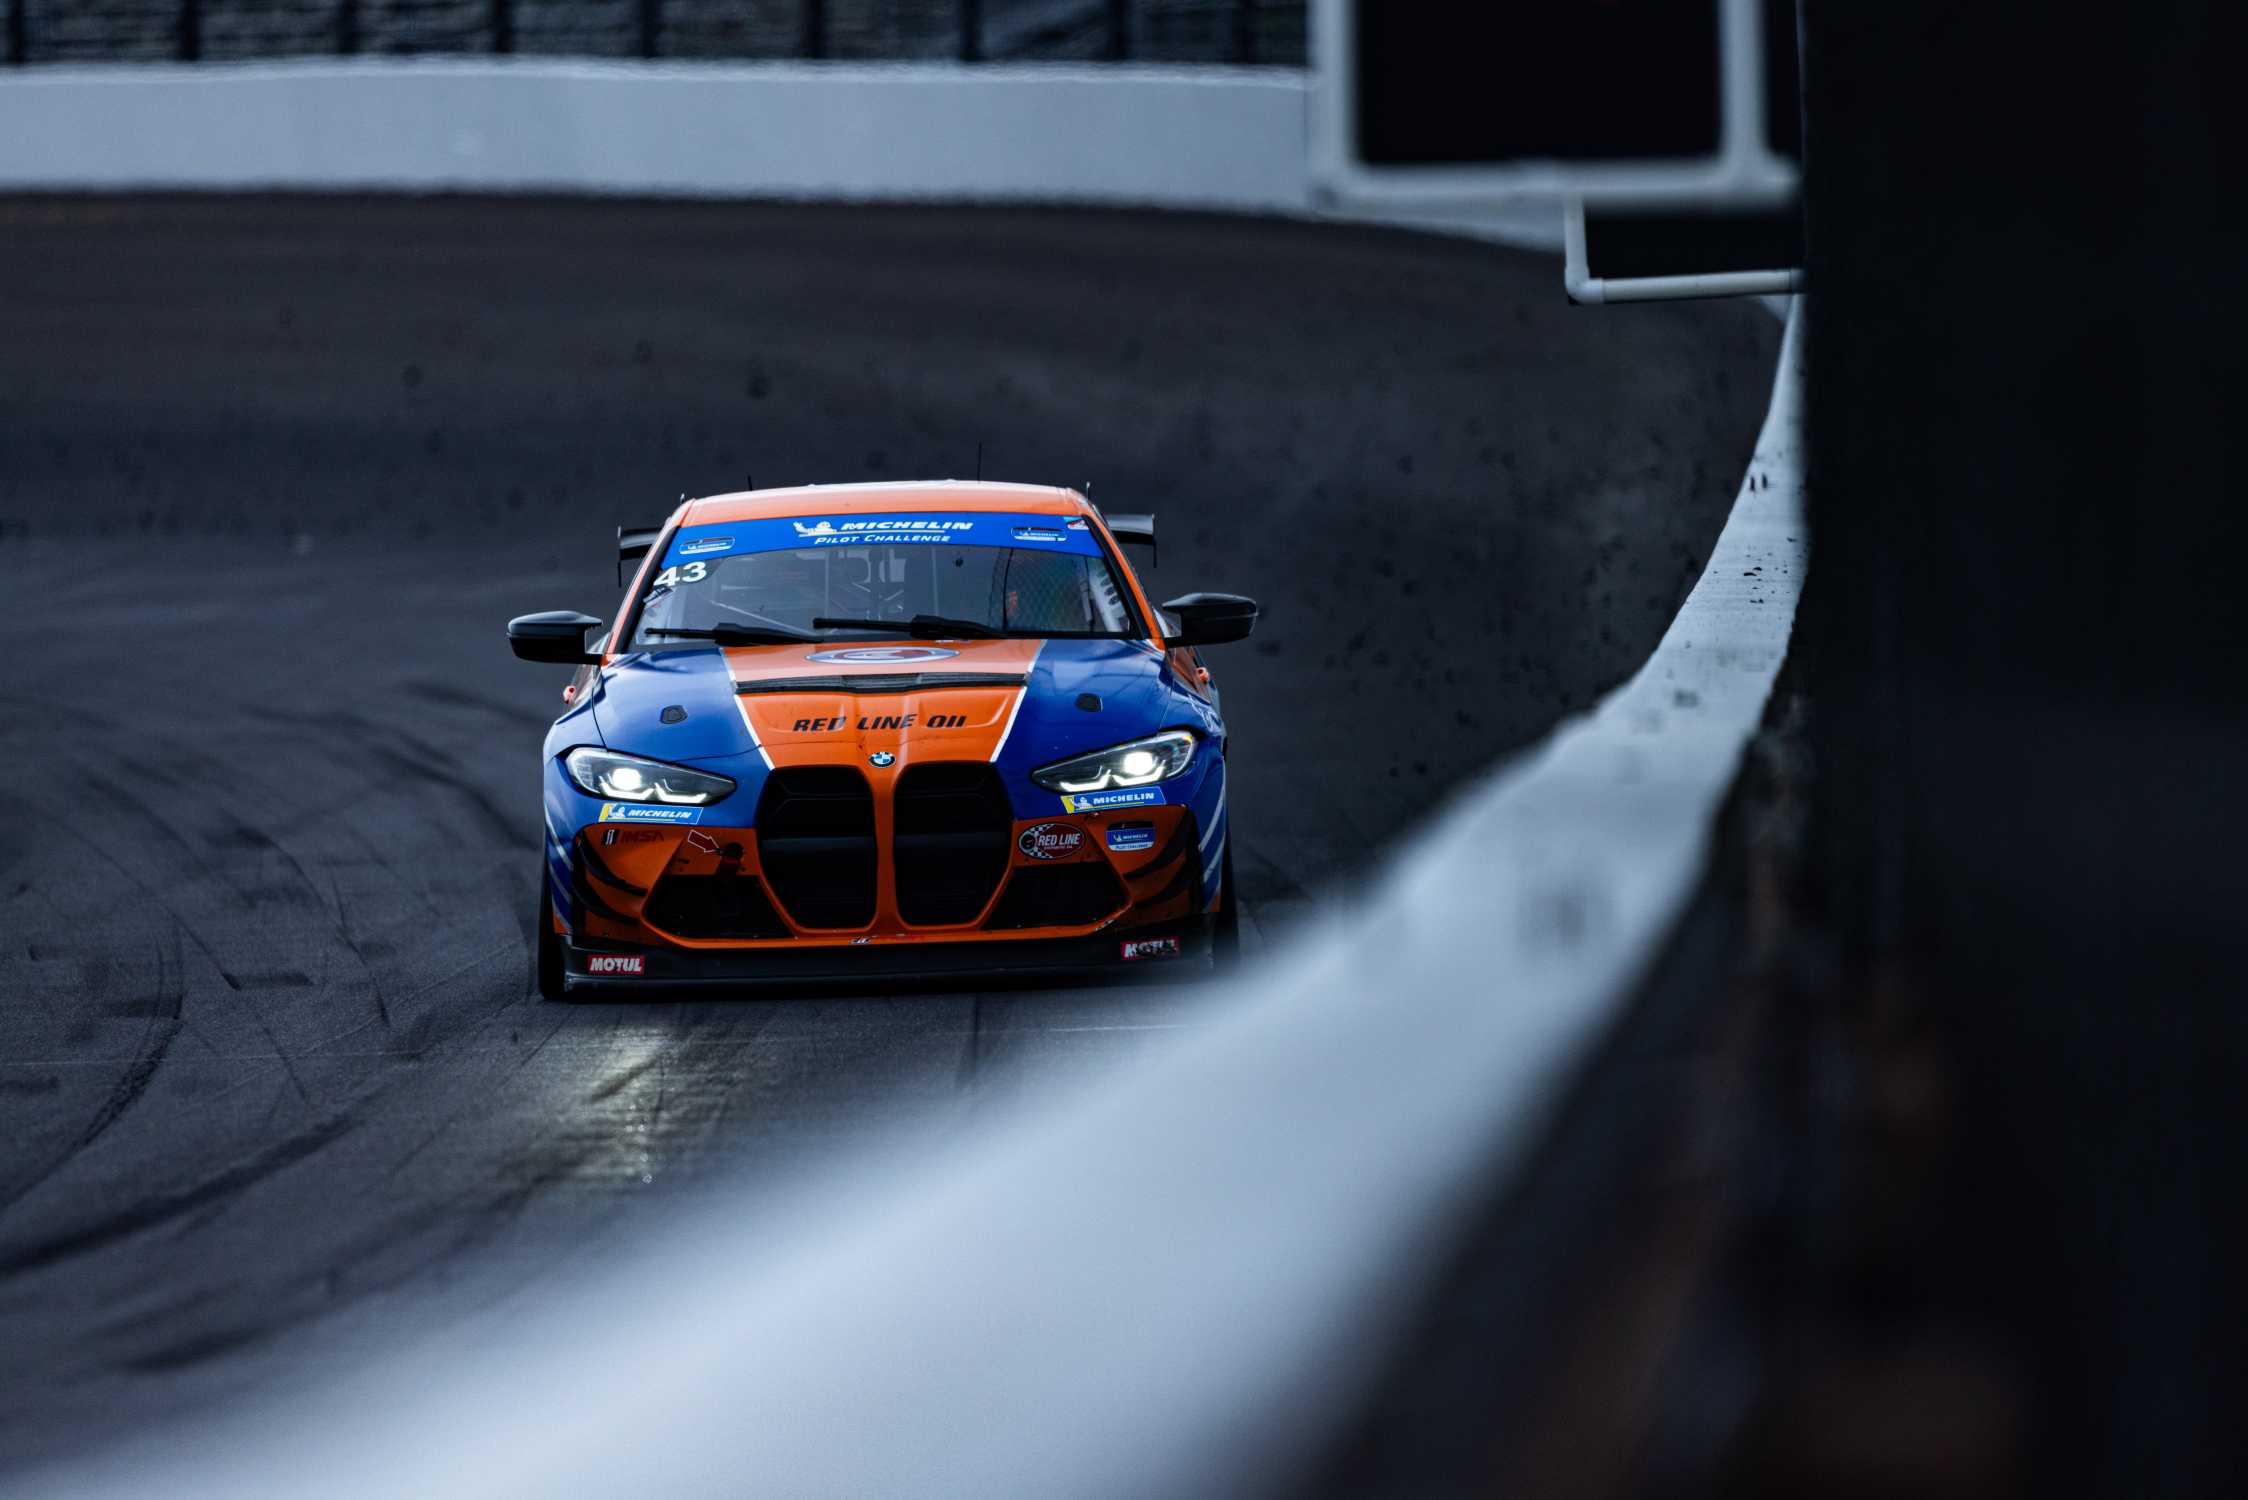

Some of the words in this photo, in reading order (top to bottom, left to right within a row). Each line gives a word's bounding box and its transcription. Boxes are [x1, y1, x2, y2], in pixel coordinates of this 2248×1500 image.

[840, 521, 974, 530] MICHELIN
[814, 536, 860, 545] PILOT
[864, 534, 951, 542] CHALLENGE
[653, 561, 707, 587] 43
[792, 716, 847, 732] RED
[856, 713, 918, 730] LINE
[1093, 792, 1155, 804] MICHELIN
[627, 809, 692, 819] MICHELIN
[1038, 834, 1058, 846] RED
[1059, 833, 1081, 845] LINE
[590, 957, 642, 972] MOTUL
